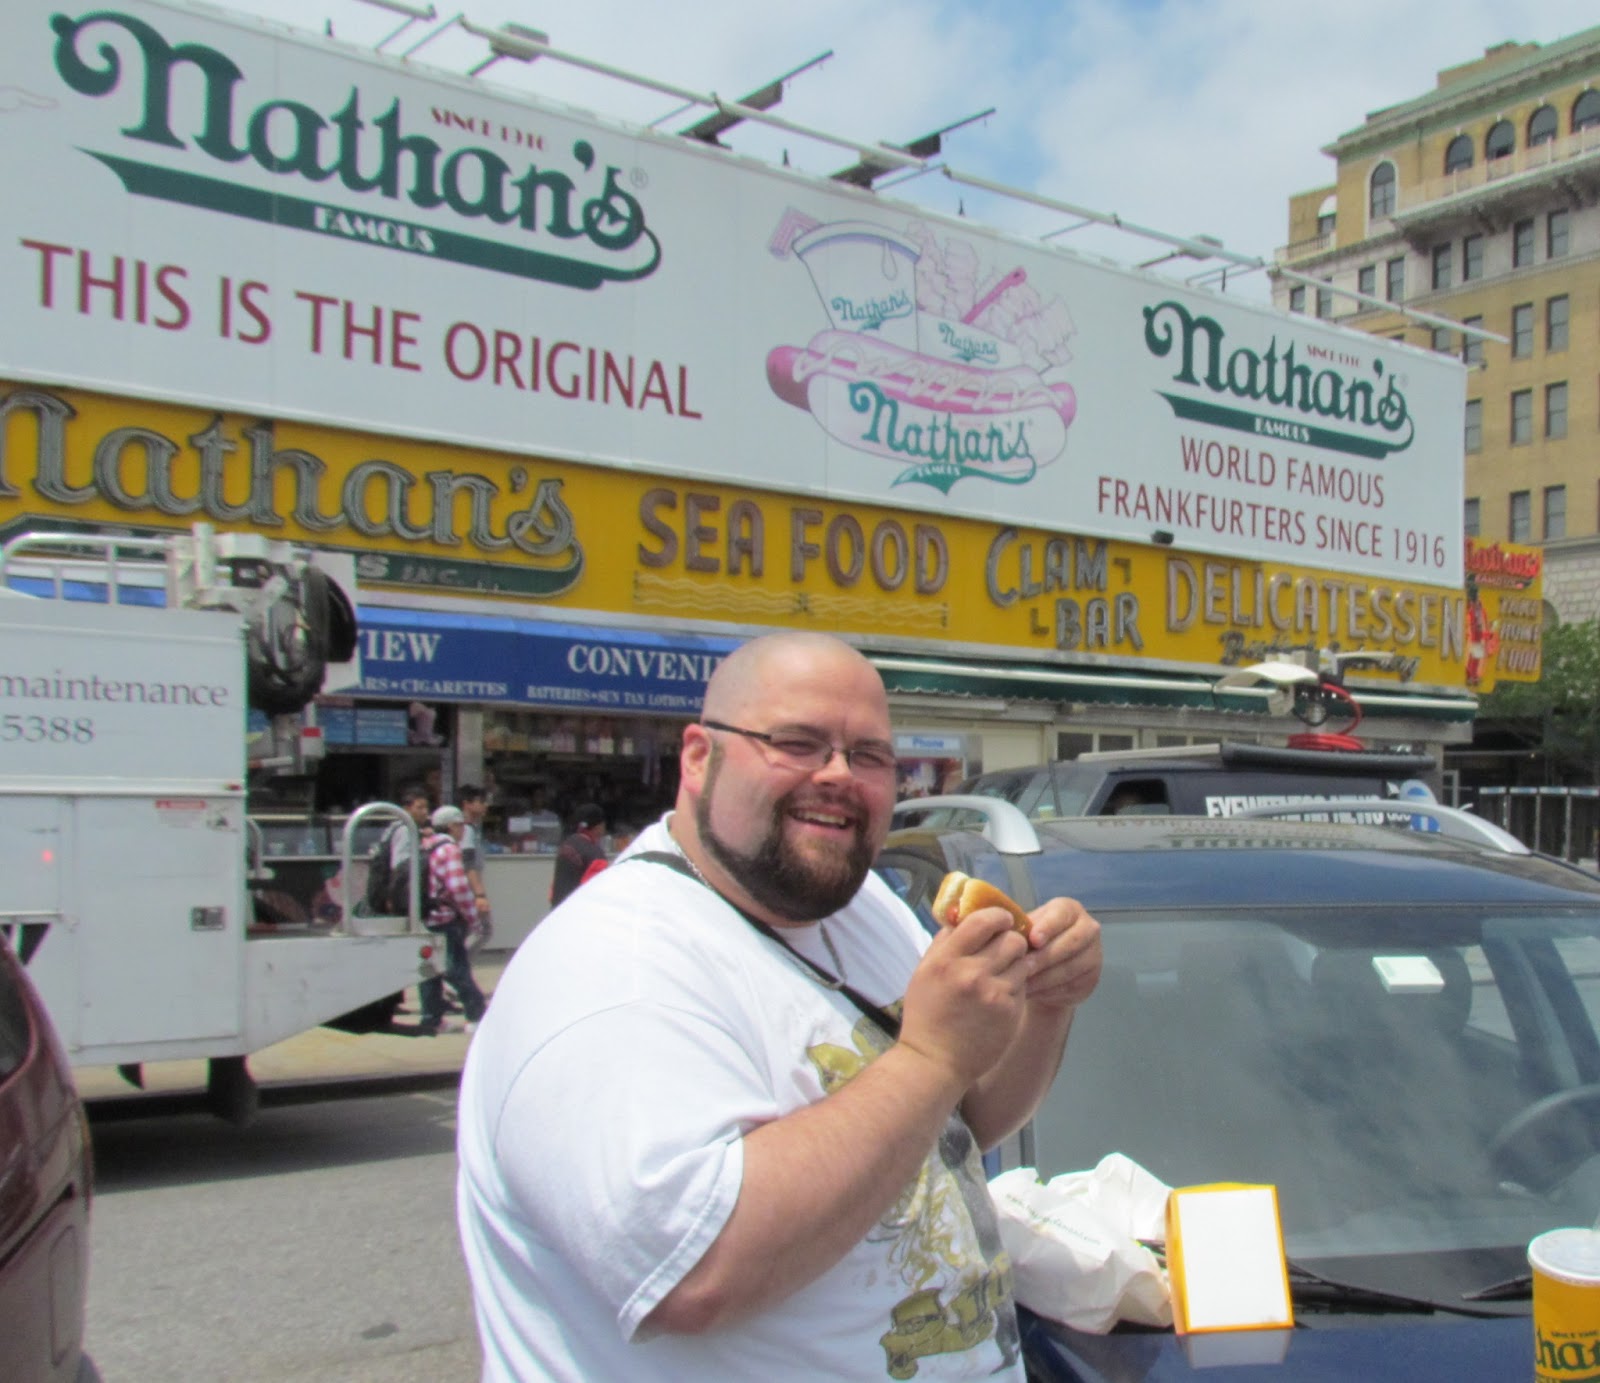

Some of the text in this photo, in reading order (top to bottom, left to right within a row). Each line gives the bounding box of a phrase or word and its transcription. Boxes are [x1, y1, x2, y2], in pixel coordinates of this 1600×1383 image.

[50, 11, 645, 251] Nathan's
[314, 206, 437, 254] FAMOUS
[21, 237, 703, 420] THIS IS THE ORIGINAL
[1143, 300, 1408, 431] Nathan's
[848, 380, 1034, 464] Nathan's
[1254, 417, 1311, 443] FAMOUS
[1180, 435, 1385, 509] WORLD FAMOUS
[638, 488, 949, 595] SEA FOOD
[1098, 476, 1446, 568] FRANKFURTERS SINCE 1916
[986, 527, 1108, 608] CLAM
[357, 629, 442, 664] IEW
[1056, 592, 1145, 652] BAR
[1166, 556, 1465, 661] DELICATESSEN
[0, 668, 229, 708] maintenance
[402, 678, 509, 697] CIGARETTES
[1, 714, 97, 745] 5388
